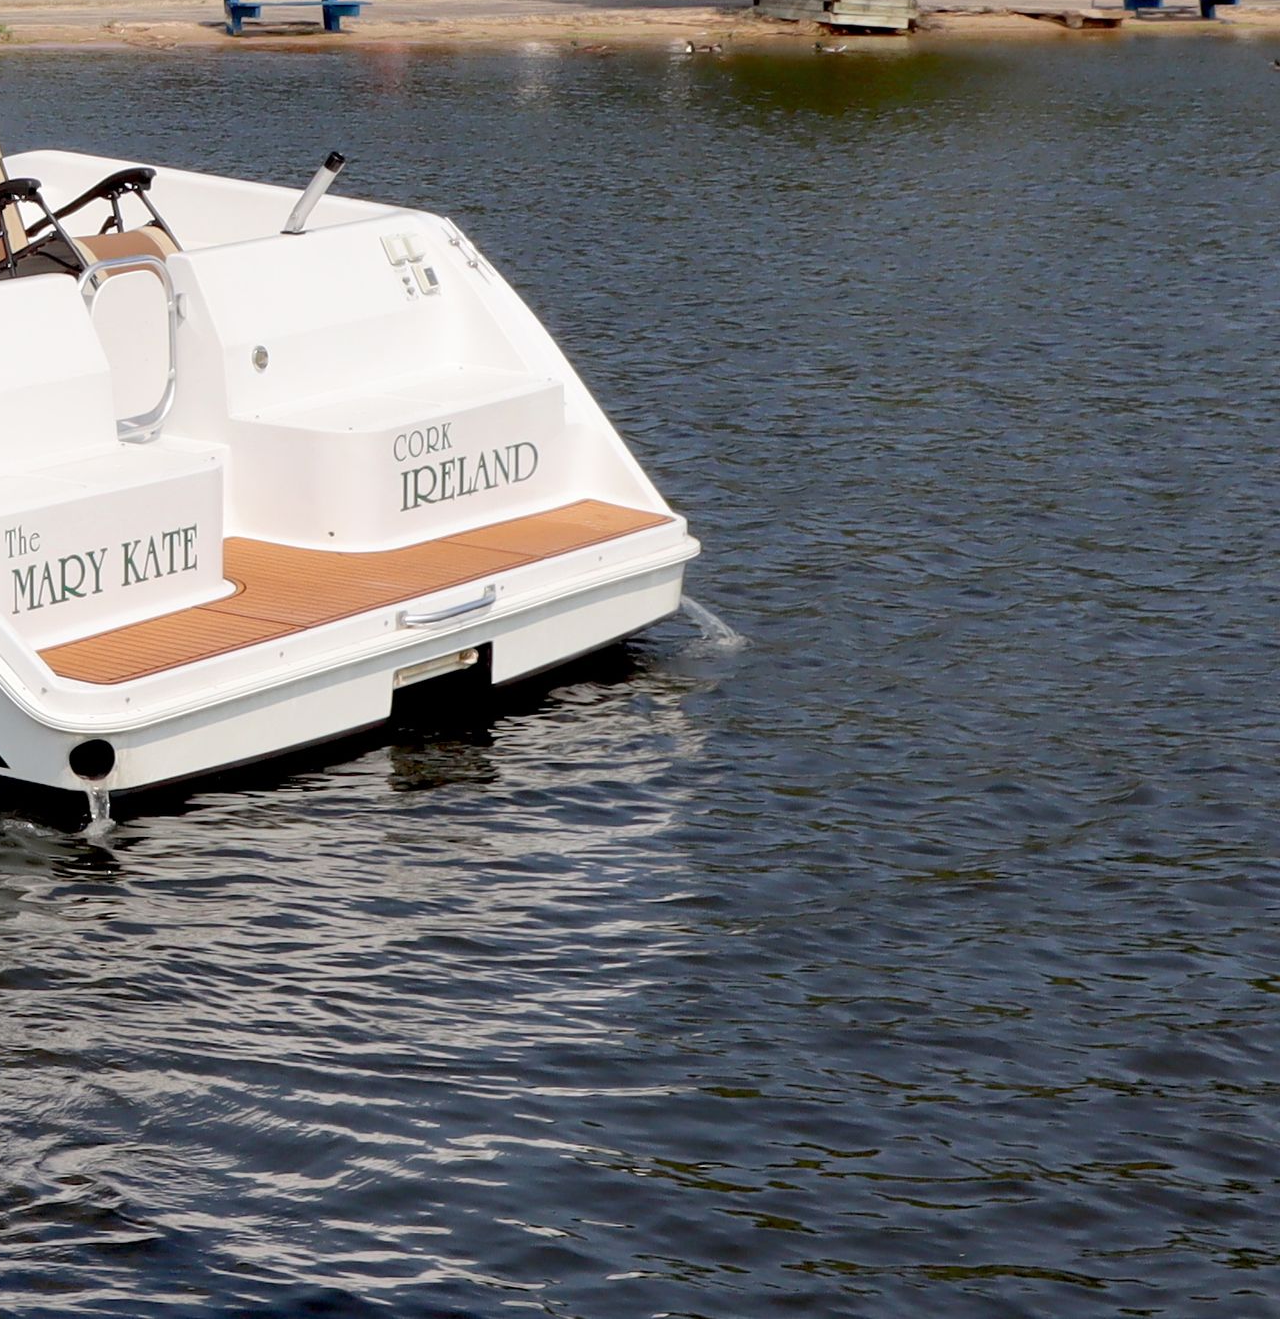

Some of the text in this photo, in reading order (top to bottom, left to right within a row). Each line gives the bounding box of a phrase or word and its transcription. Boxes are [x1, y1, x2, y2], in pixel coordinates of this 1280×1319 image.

[393, 422, 452, 462] CORK
[400, 442, 539, 512] IRELAND
[5, 525, 40, 558] The
[12, 523, 198, 615] MARY KATE
